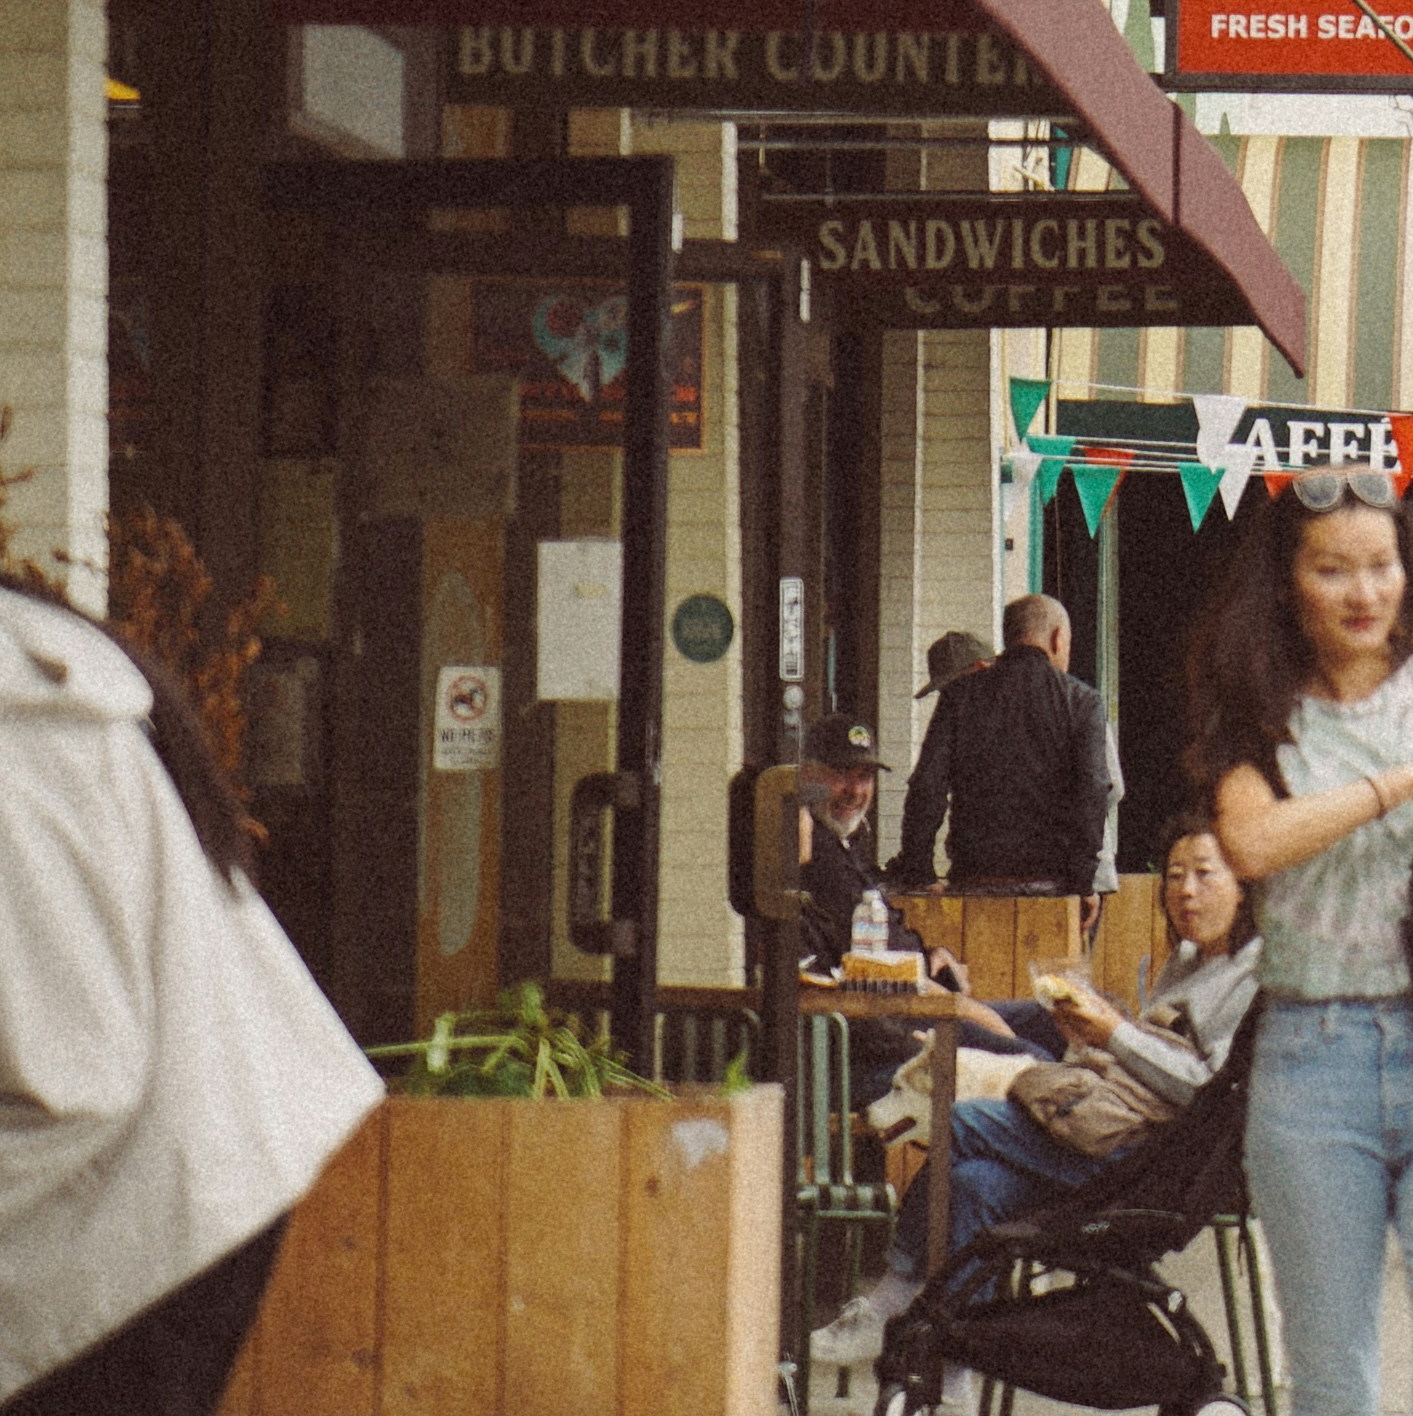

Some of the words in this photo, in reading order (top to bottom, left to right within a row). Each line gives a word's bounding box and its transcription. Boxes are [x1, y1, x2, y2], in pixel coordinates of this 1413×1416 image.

[1210, 13, 1308, 40] FRESH
[455, 26, 741, 81] BUTCHER
[817, 219, 1167, 271] SANDWICHES
